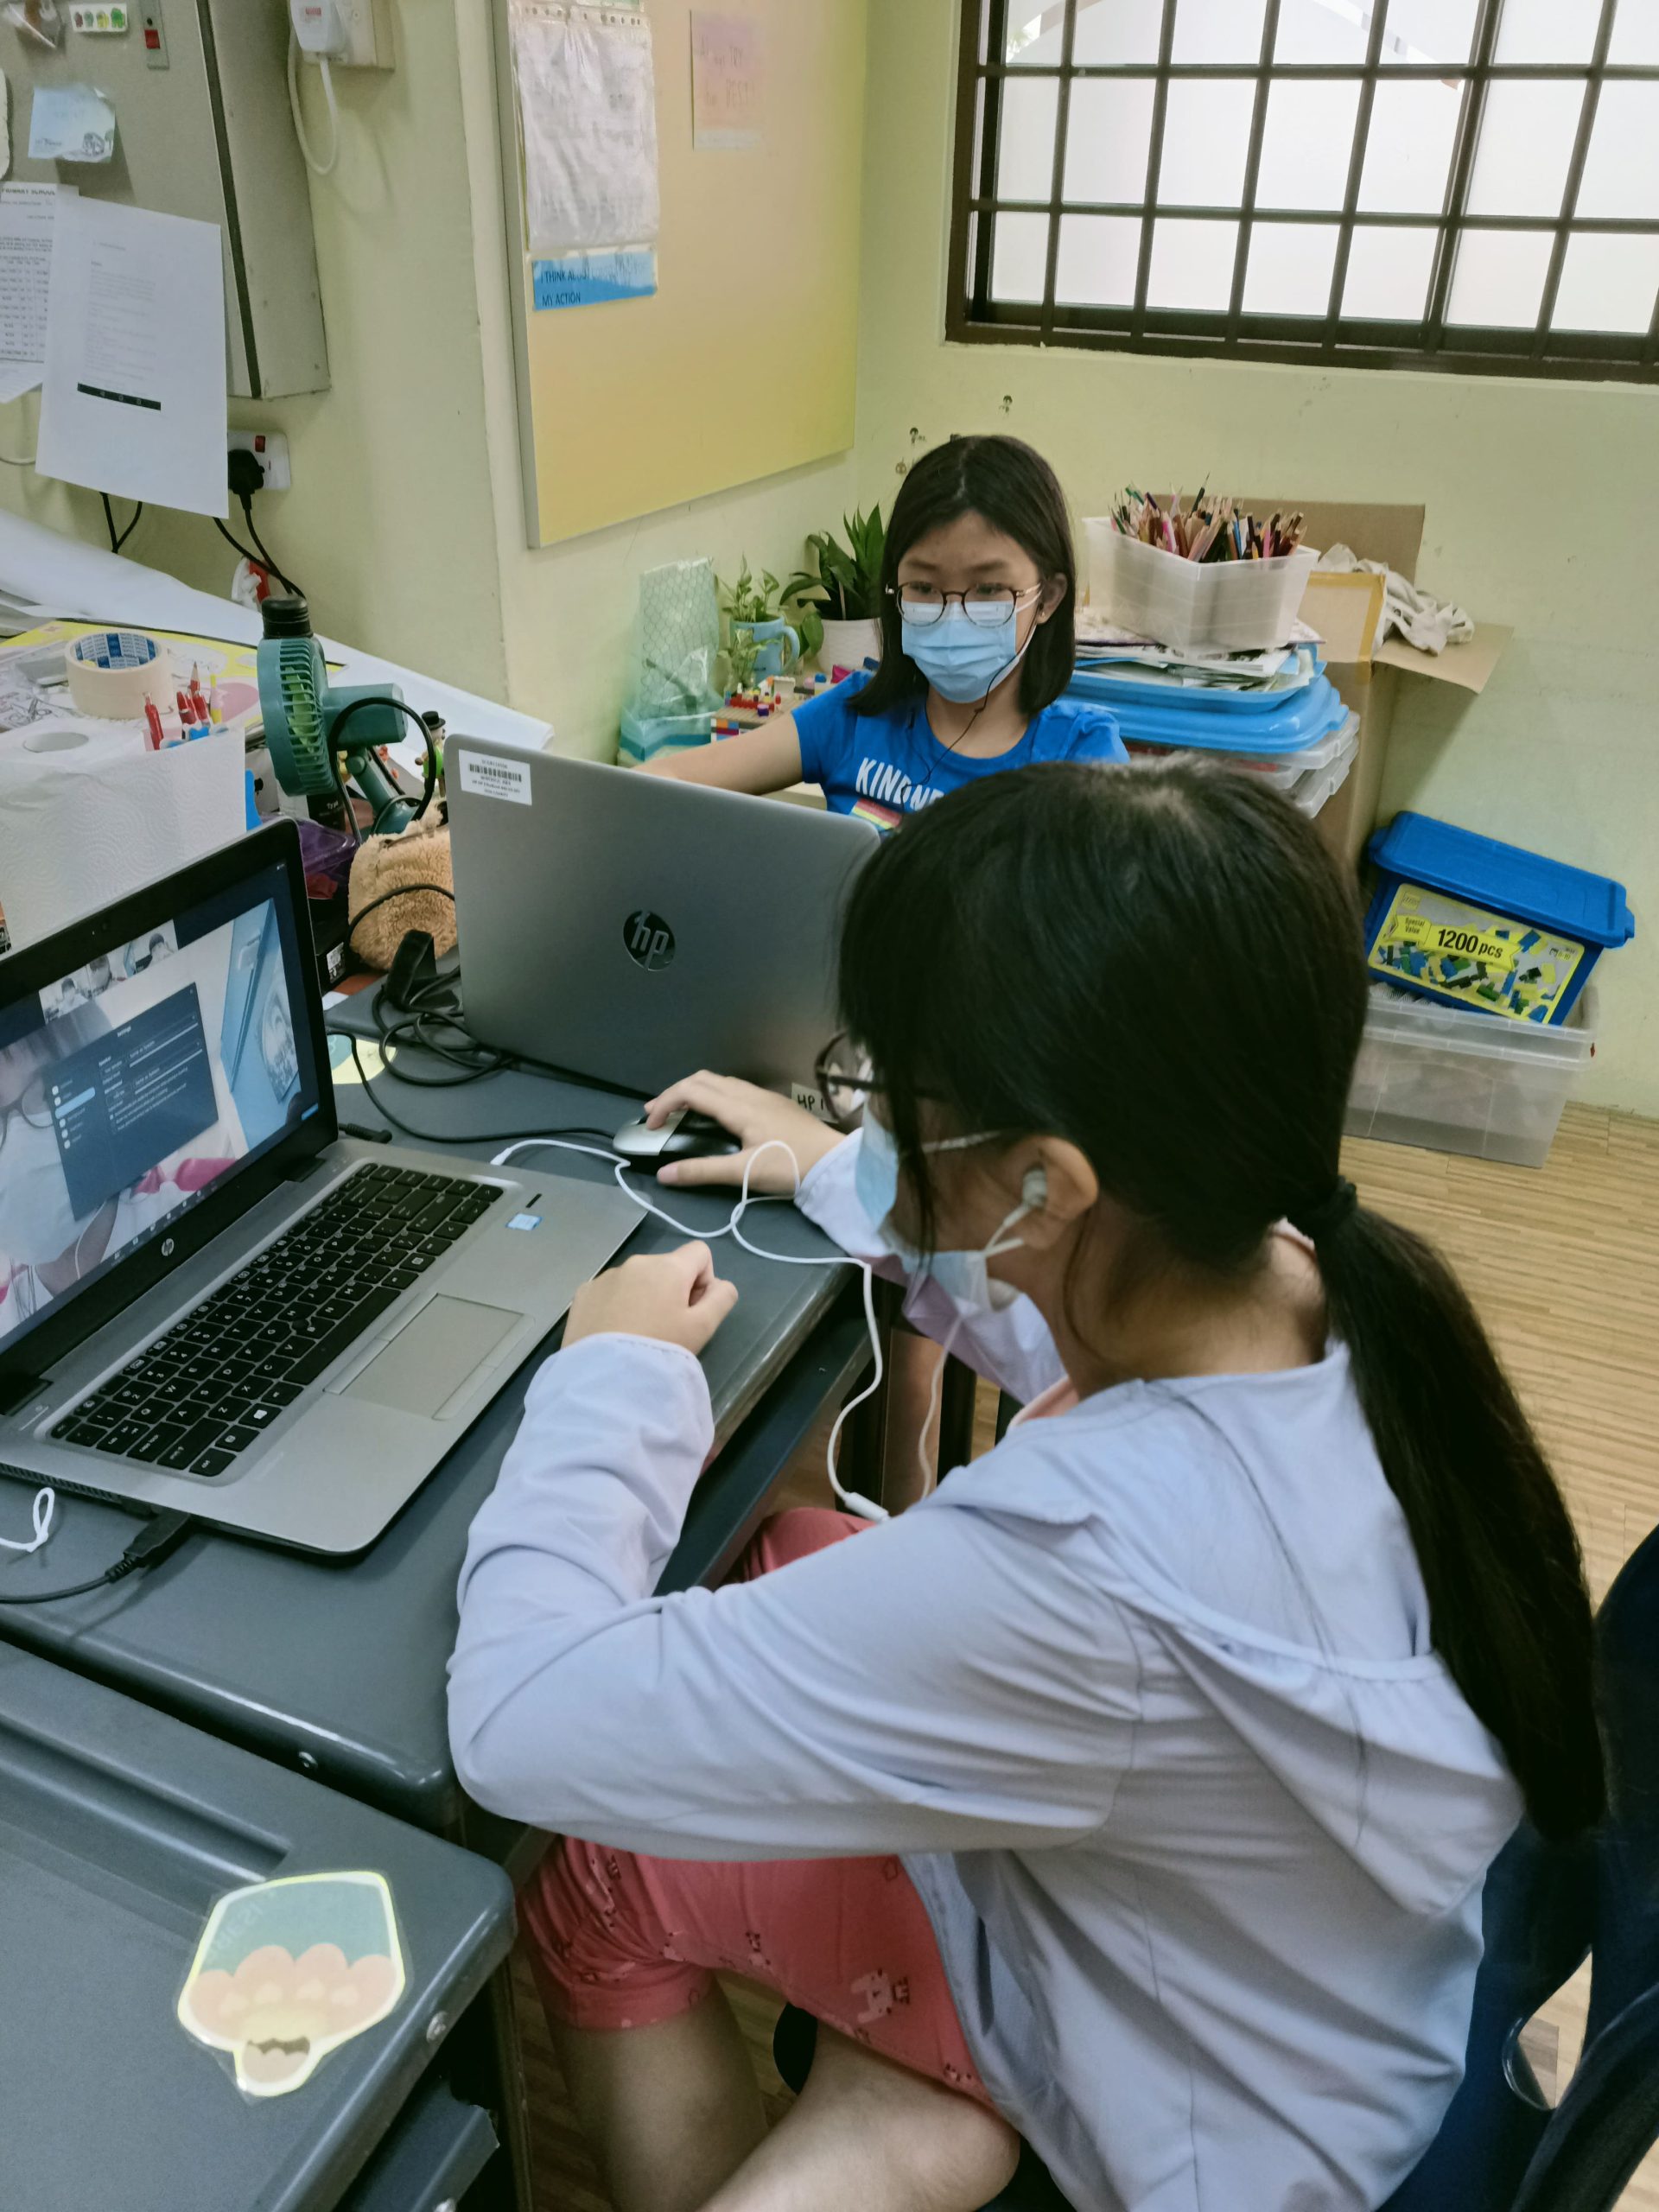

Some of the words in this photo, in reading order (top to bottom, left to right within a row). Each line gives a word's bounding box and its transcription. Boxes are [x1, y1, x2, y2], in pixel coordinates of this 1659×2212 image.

[543, 270, 566, 283] THINK
[542, 293, 554, 307] MY
[555, 292, 582, 306] ACTION
[1438, 928, 1479, 954] 1200
[1478, 943, 1503, 959] pcs
